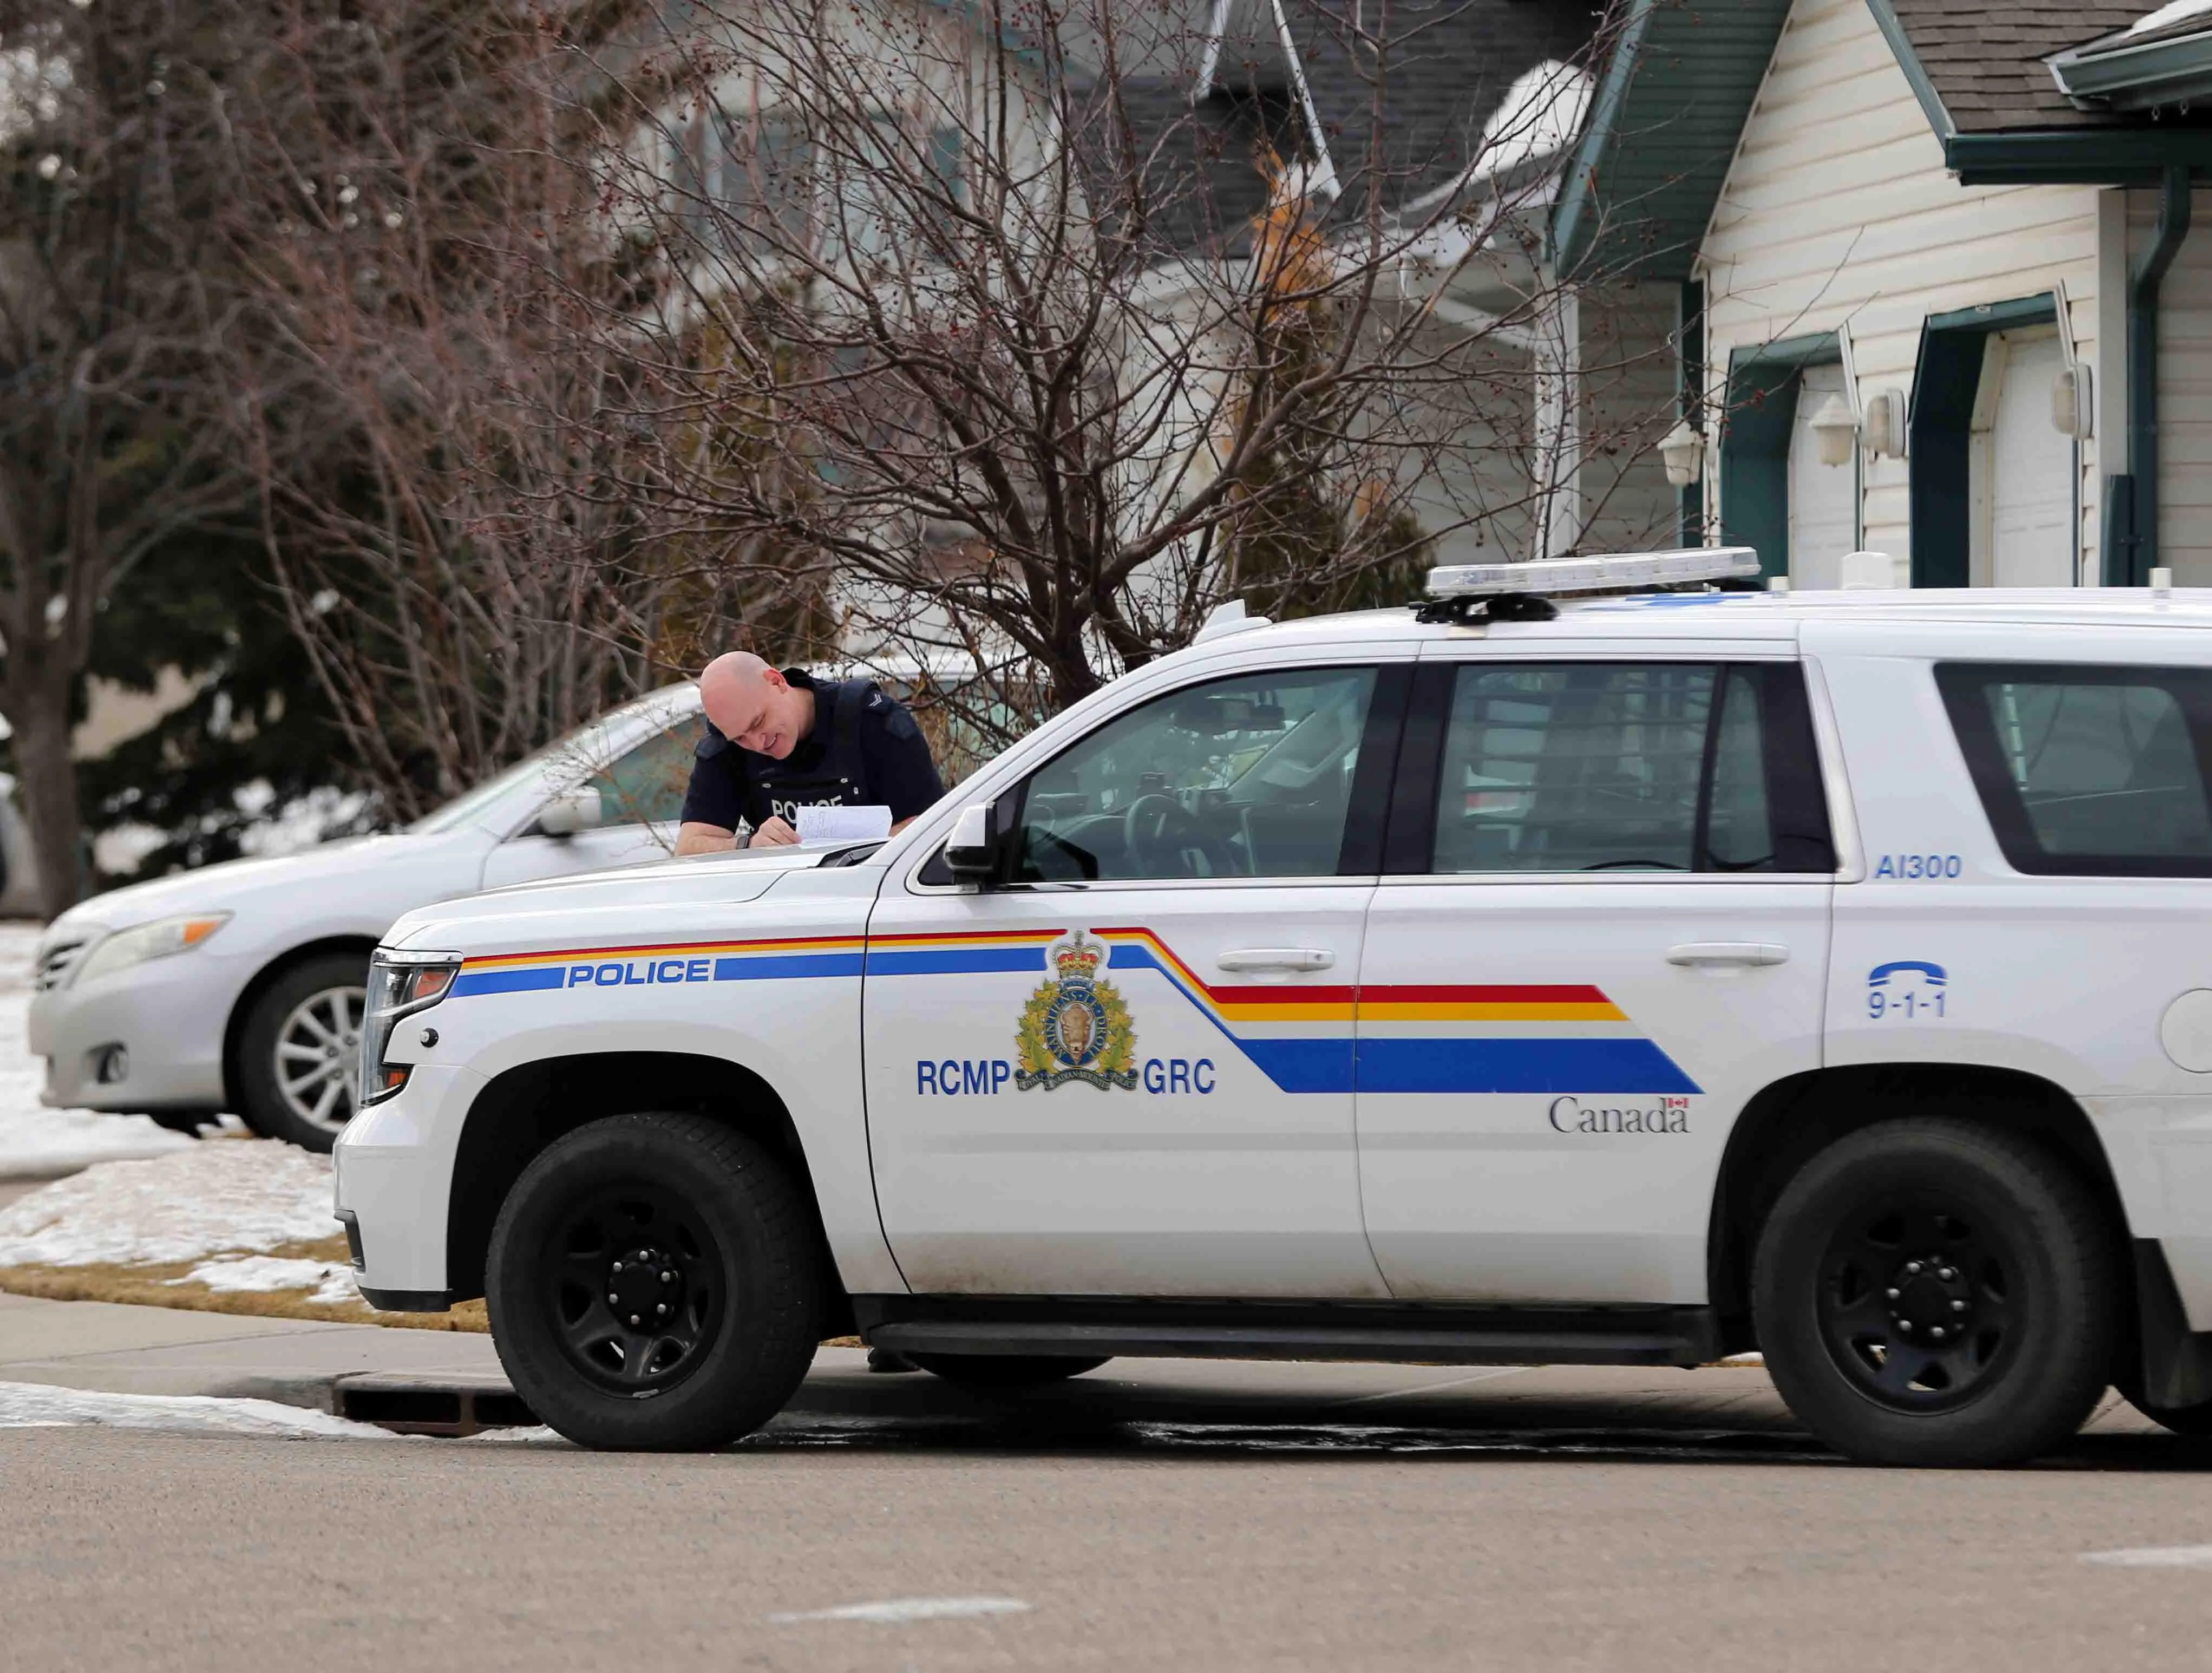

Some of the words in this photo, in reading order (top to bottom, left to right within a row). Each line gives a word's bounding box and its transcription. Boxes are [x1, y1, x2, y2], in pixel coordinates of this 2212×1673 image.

[568, 959, 710, 988] POLICE
[1869, 991, 1946, 1019] 9-1-1
[918, 1061, 1010, 1095] RCMP
[1144, 1059, 1215, 1094] GRC
[1550, 1096, 1692, 1133] Canada
